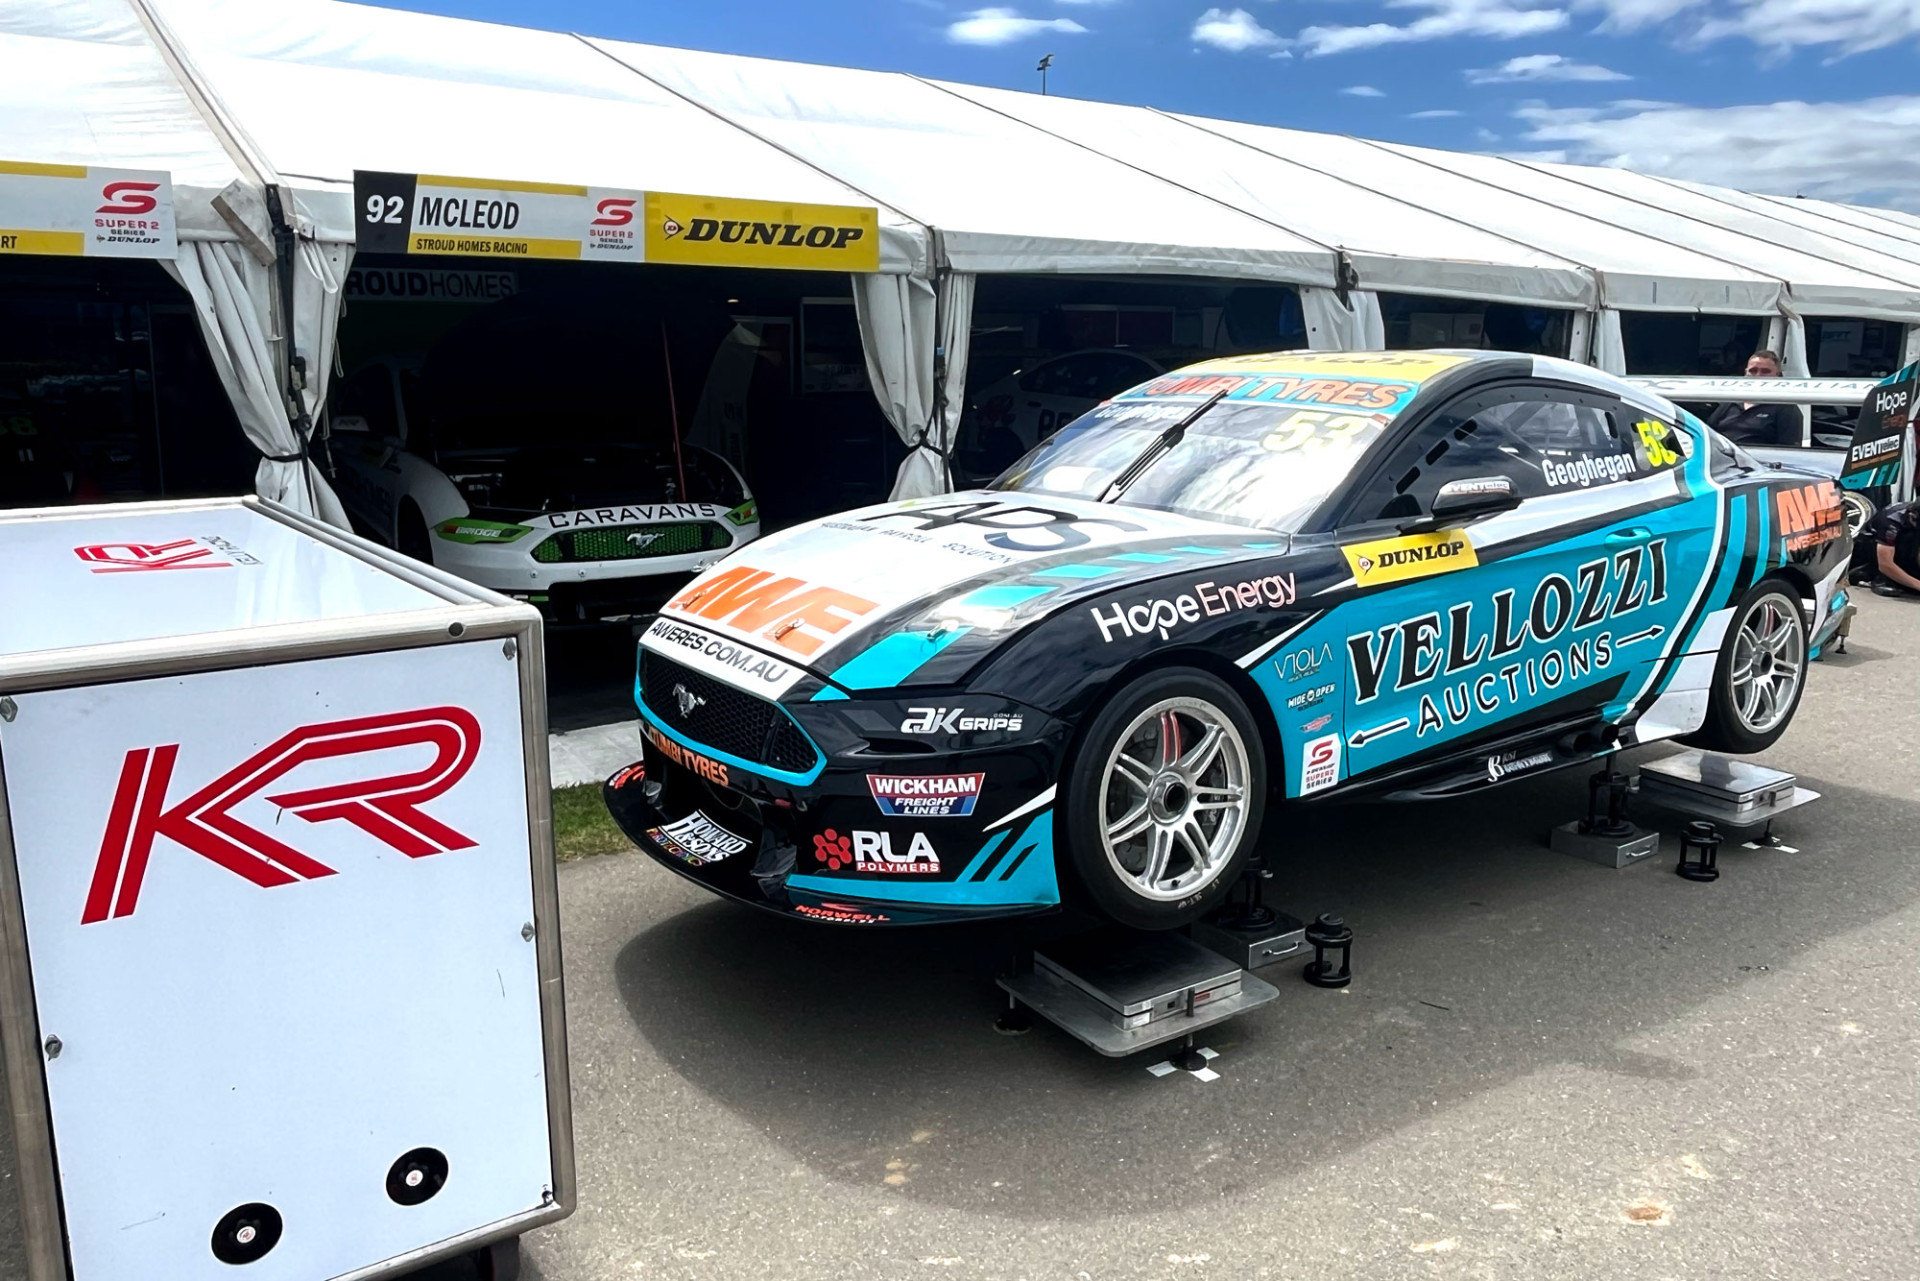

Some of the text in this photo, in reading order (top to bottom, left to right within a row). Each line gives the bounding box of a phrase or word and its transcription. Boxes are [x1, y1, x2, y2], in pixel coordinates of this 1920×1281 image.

[366, 194, 404, 224] 92
[419, 196, 520, 230] MCLEOD
[95, 218, 159, 230] SUPER 2
[589, 229, 625, 238] SUPER
[683, 218, 863, 248] DUNLOP
[1, 235, 17, 249] RT
[107, 236, 161, 244] DUNLOP
[416, 238, 528, 254] STROUD HOMES RACING
[1247, 376, 1411, 409] TYRES
[1876, 391, 1907, 415] Hope
[1636, 421, 1677, 467] 53
[1541, 452, 1637, 487] Geoghegan
[548, 503, 716, 529] CARAVANS
[1378, 540, 1464, 568] DUNLOP
[667, 566, 881, 657] AWE
[1090, 572, 1297, 643] Hope Energy
[1347, 539, 1668, 705] VELLOZZI
[649, 620, 789, 683] AWERES.COM.AU
[1417, 633, 1613, 738] AUCTIONS
[959, 717, 1023, 731] GRIPS
[682, 750, 730, 787] TYRES
[875, 776, 977, 795] WICKHAM
[81, 706, 482, 925] KR
[895, 796, 958, 806] FREIGHT
[903, 806, 950, 815] LINES
[852, 830, 940, 863] RLA
[856, 863, 940, 873] POLYMERS
[795, 905, 890, 921] NORWELL
